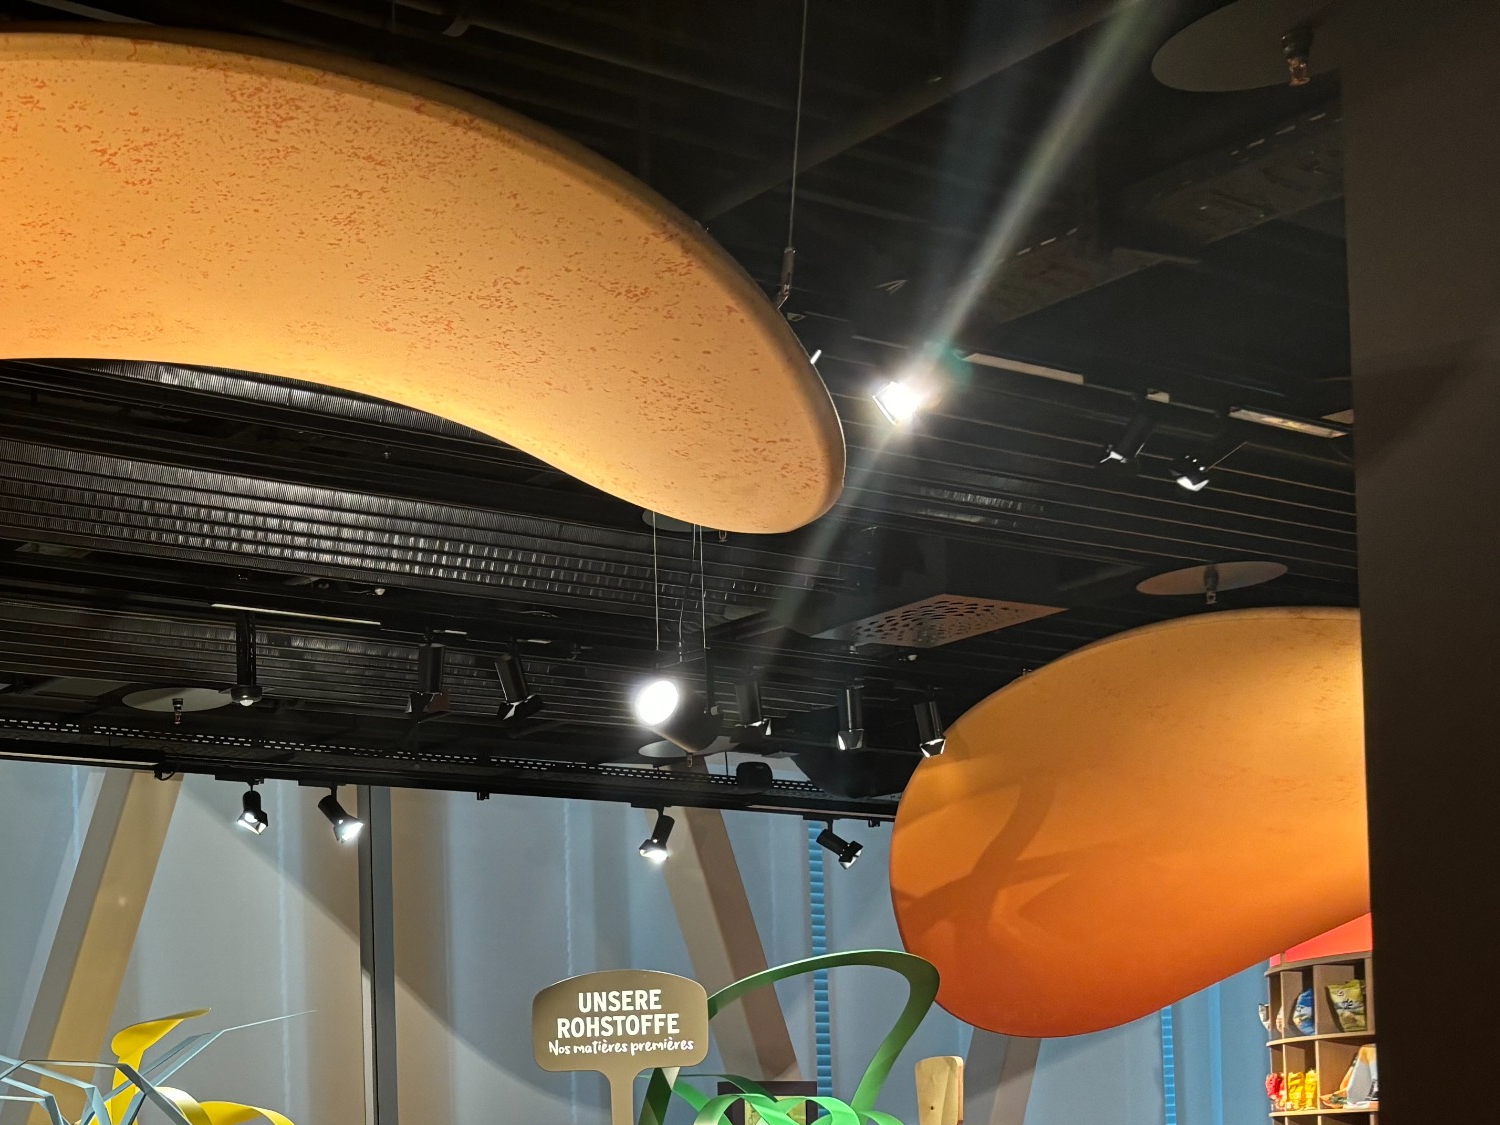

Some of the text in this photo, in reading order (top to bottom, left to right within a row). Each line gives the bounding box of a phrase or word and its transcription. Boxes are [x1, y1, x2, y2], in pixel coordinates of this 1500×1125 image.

[578, 989, 661, 1013] UNSERE
[557, 1013, 679, 1038] ROHSTOFFE
[549, 1037, 694, 1056] Nos matières premières
